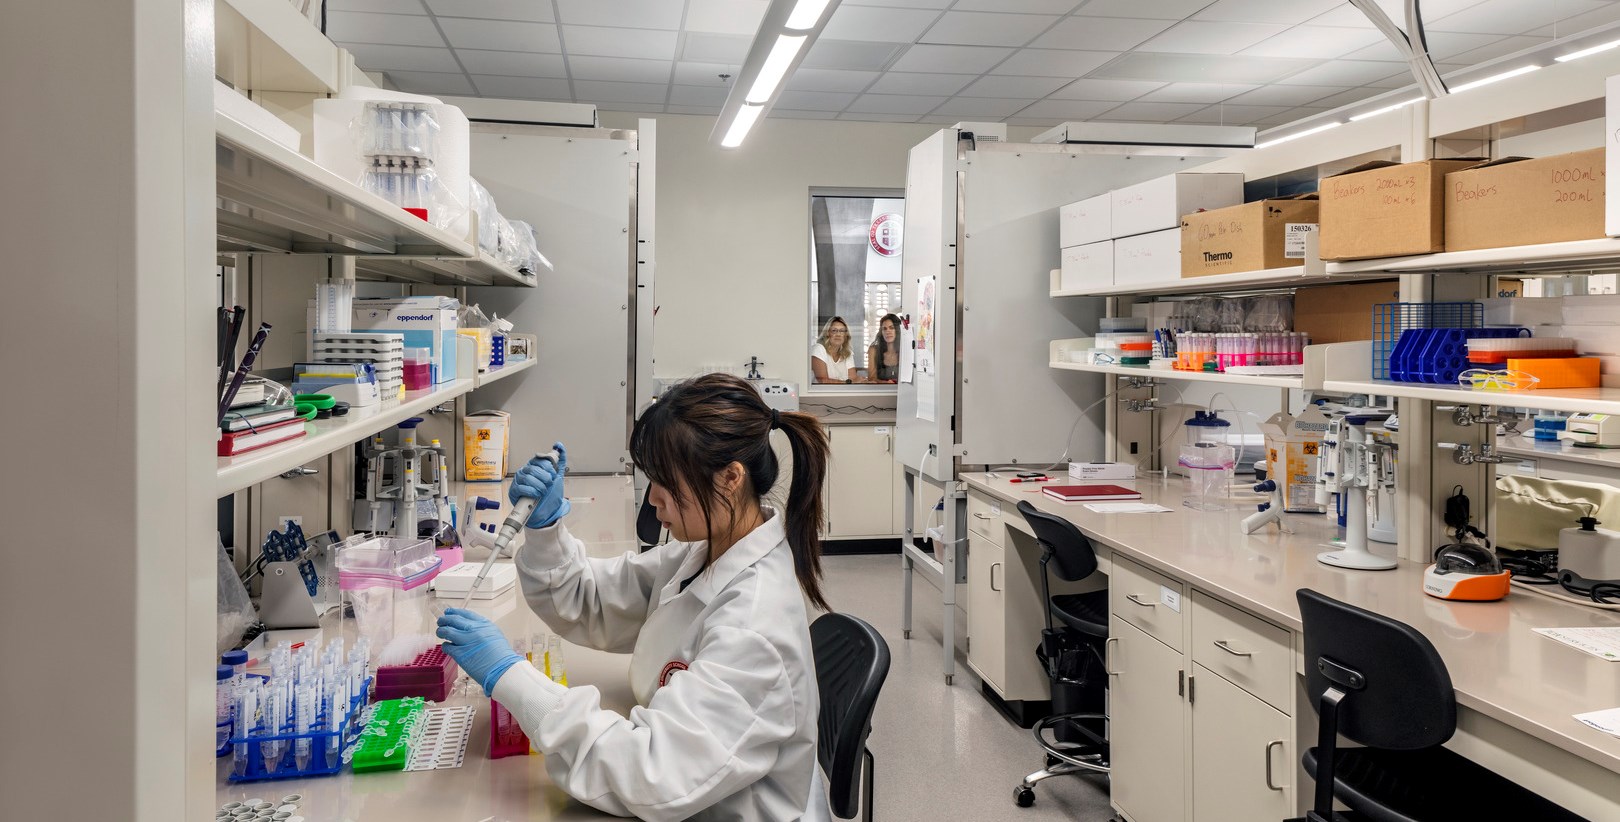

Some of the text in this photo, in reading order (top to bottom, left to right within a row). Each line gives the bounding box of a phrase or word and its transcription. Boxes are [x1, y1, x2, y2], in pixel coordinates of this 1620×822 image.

[1333, 181, 1365, 200] Beakers
[1455, 181, 1497, 202] Beakers
[1203, 251, 1233, 262] Thermo
[1205, 260, 1233, 268] SCIENTIFIC
